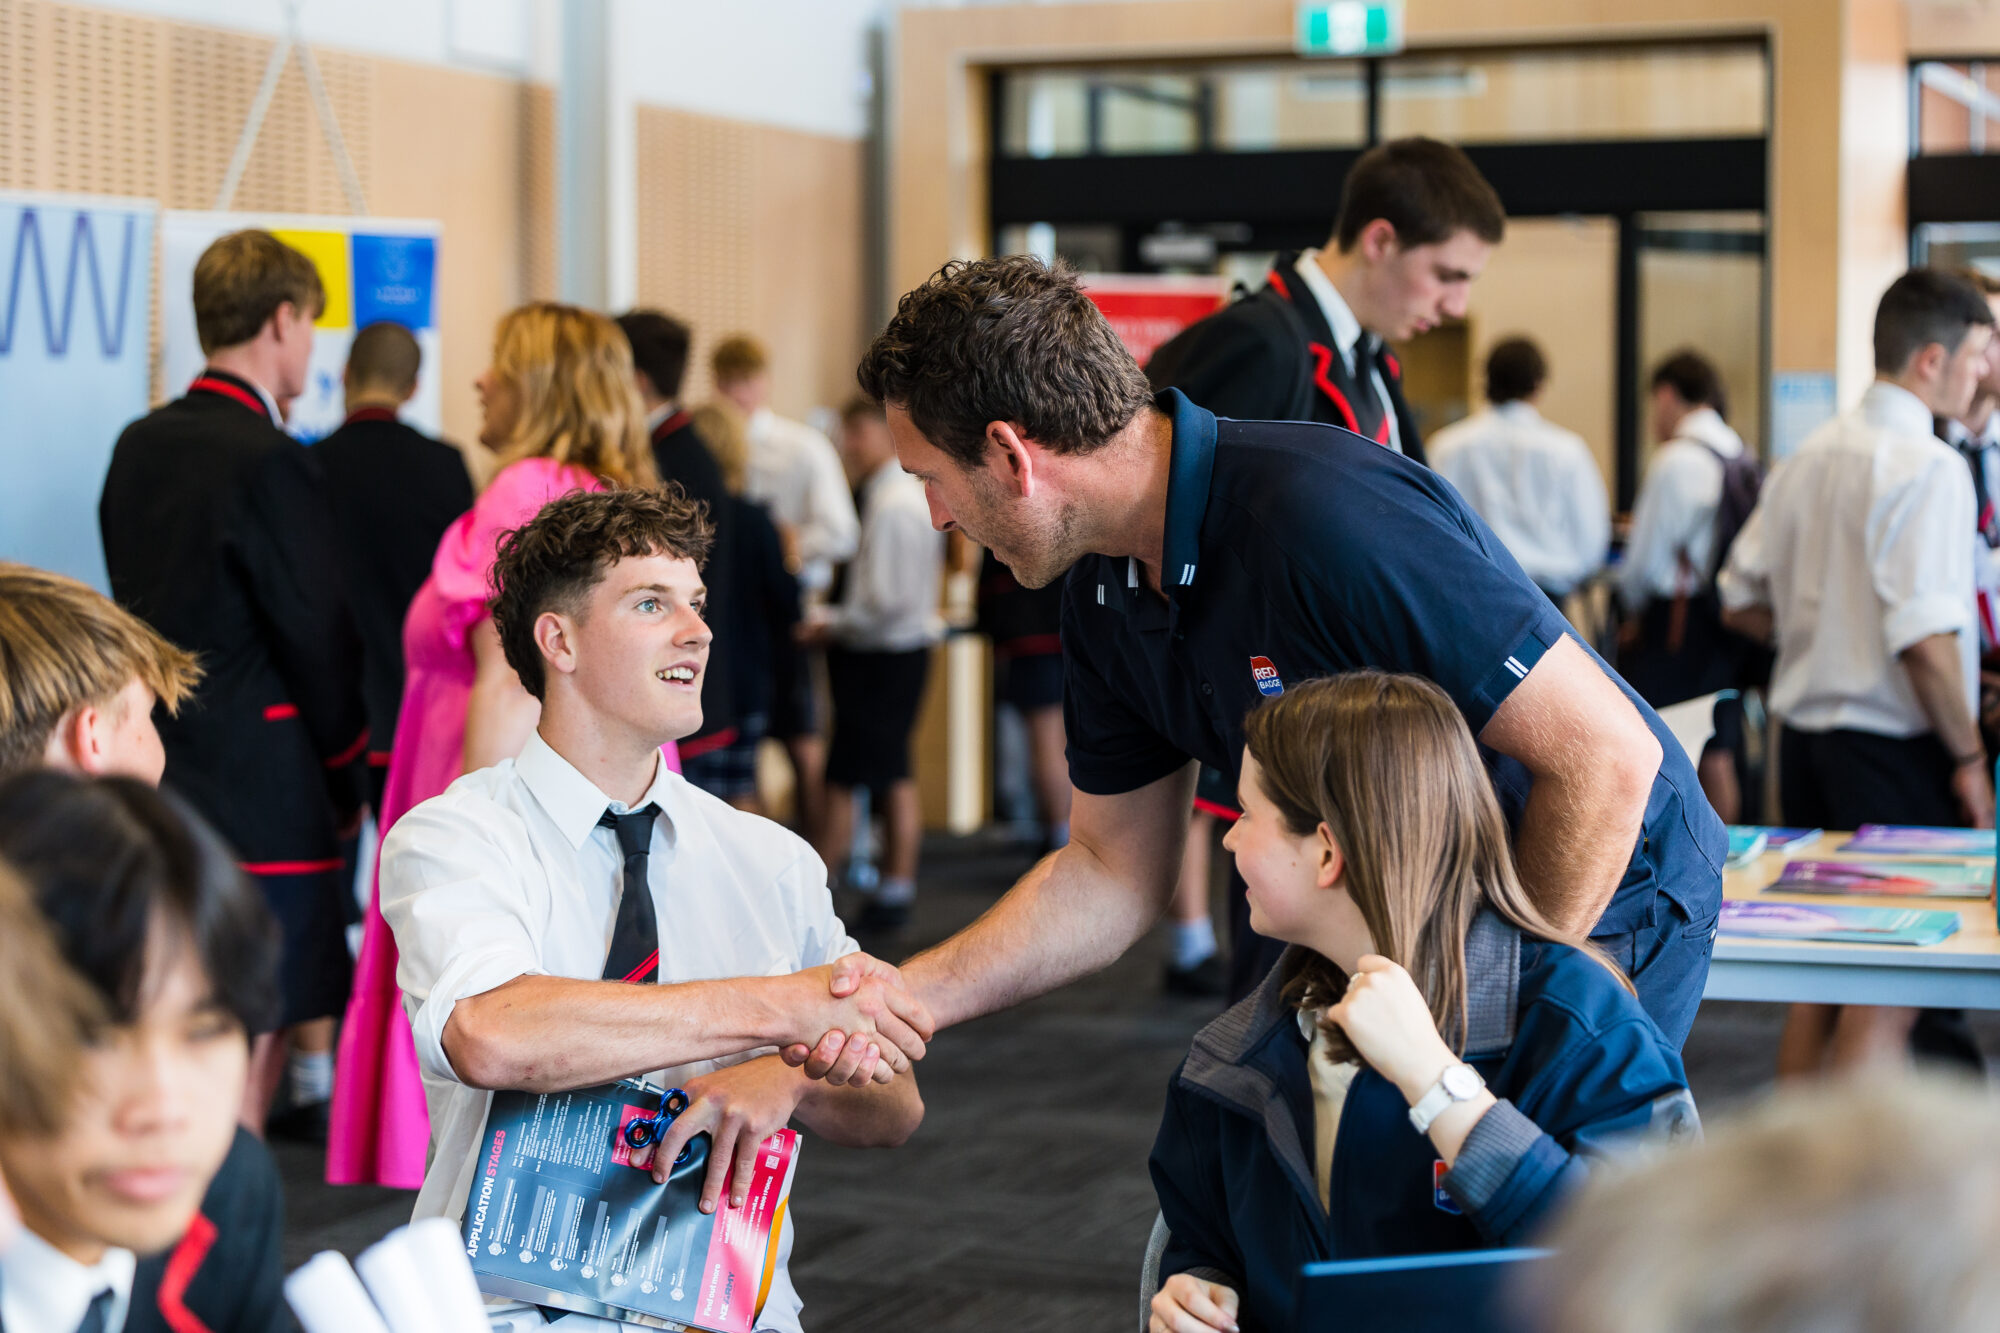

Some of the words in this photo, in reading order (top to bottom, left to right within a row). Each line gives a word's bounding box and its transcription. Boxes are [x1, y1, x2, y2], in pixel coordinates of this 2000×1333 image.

[1254, 667, 1277, 681] RED
[1259, 679, 1280, 689] BADGE
[466, 1177, 494, 1257] APPLICATION
[486, 1131, 505, 1177] STAGES
[704, 1299, 713, 1316] Find
[712, 1264, 720, 1284] more
